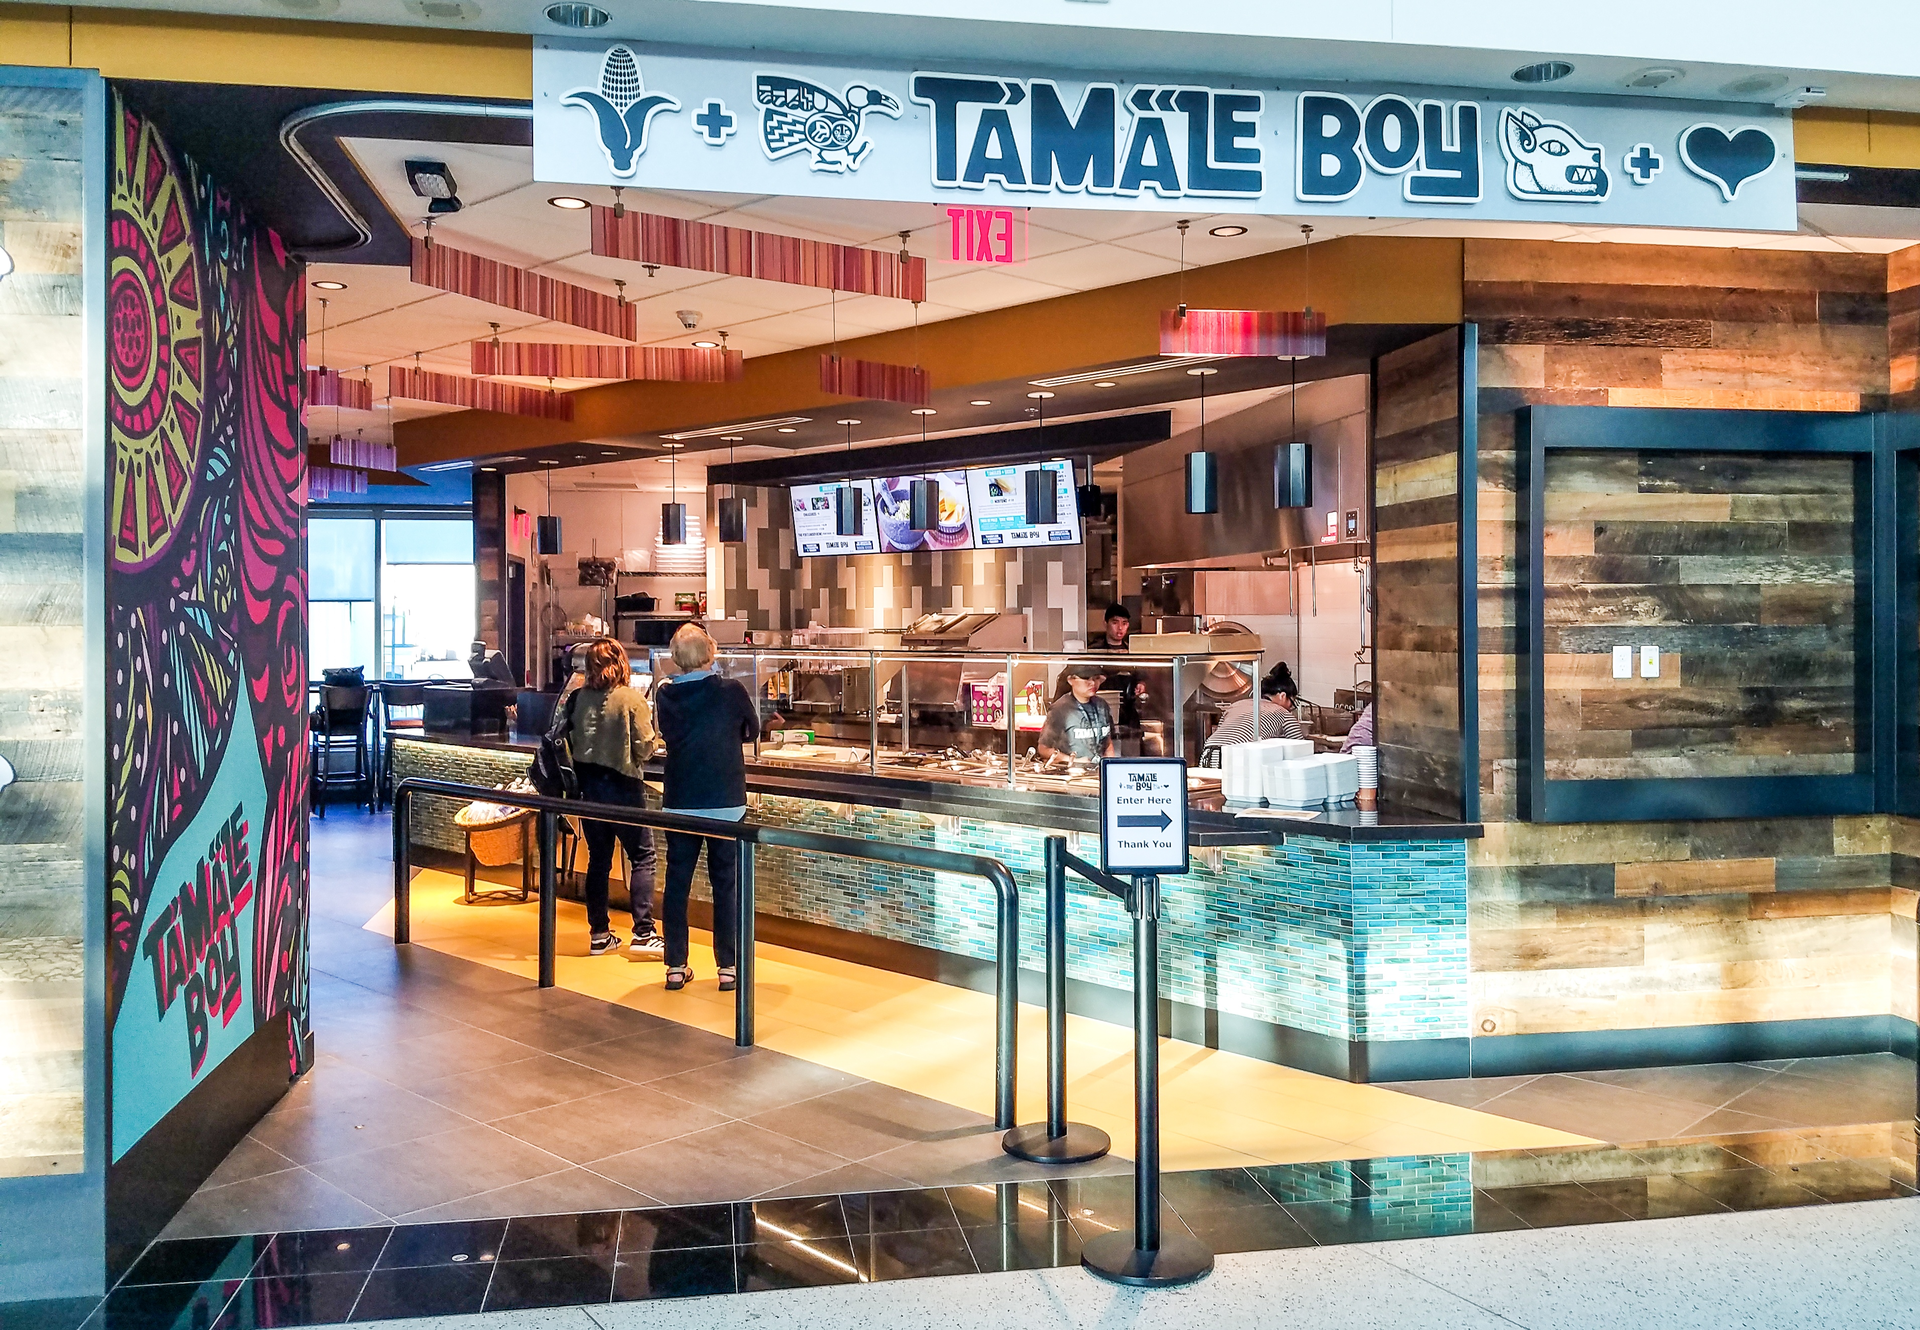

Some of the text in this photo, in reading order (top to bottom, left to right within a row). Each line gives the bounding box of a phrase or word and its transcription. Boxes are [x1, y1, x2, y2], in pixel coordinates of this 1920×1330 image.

[1301, 95, 1480, 199] BOY
[1128, 773, 1158, 782] TAMALE
[1136, 782, 1152, 791] BOY
[1117, 796, 1172, 804] Enter Here
[1118, 840, 1172, 848] Thank You
[183, 911, 243, 1080] BOY
